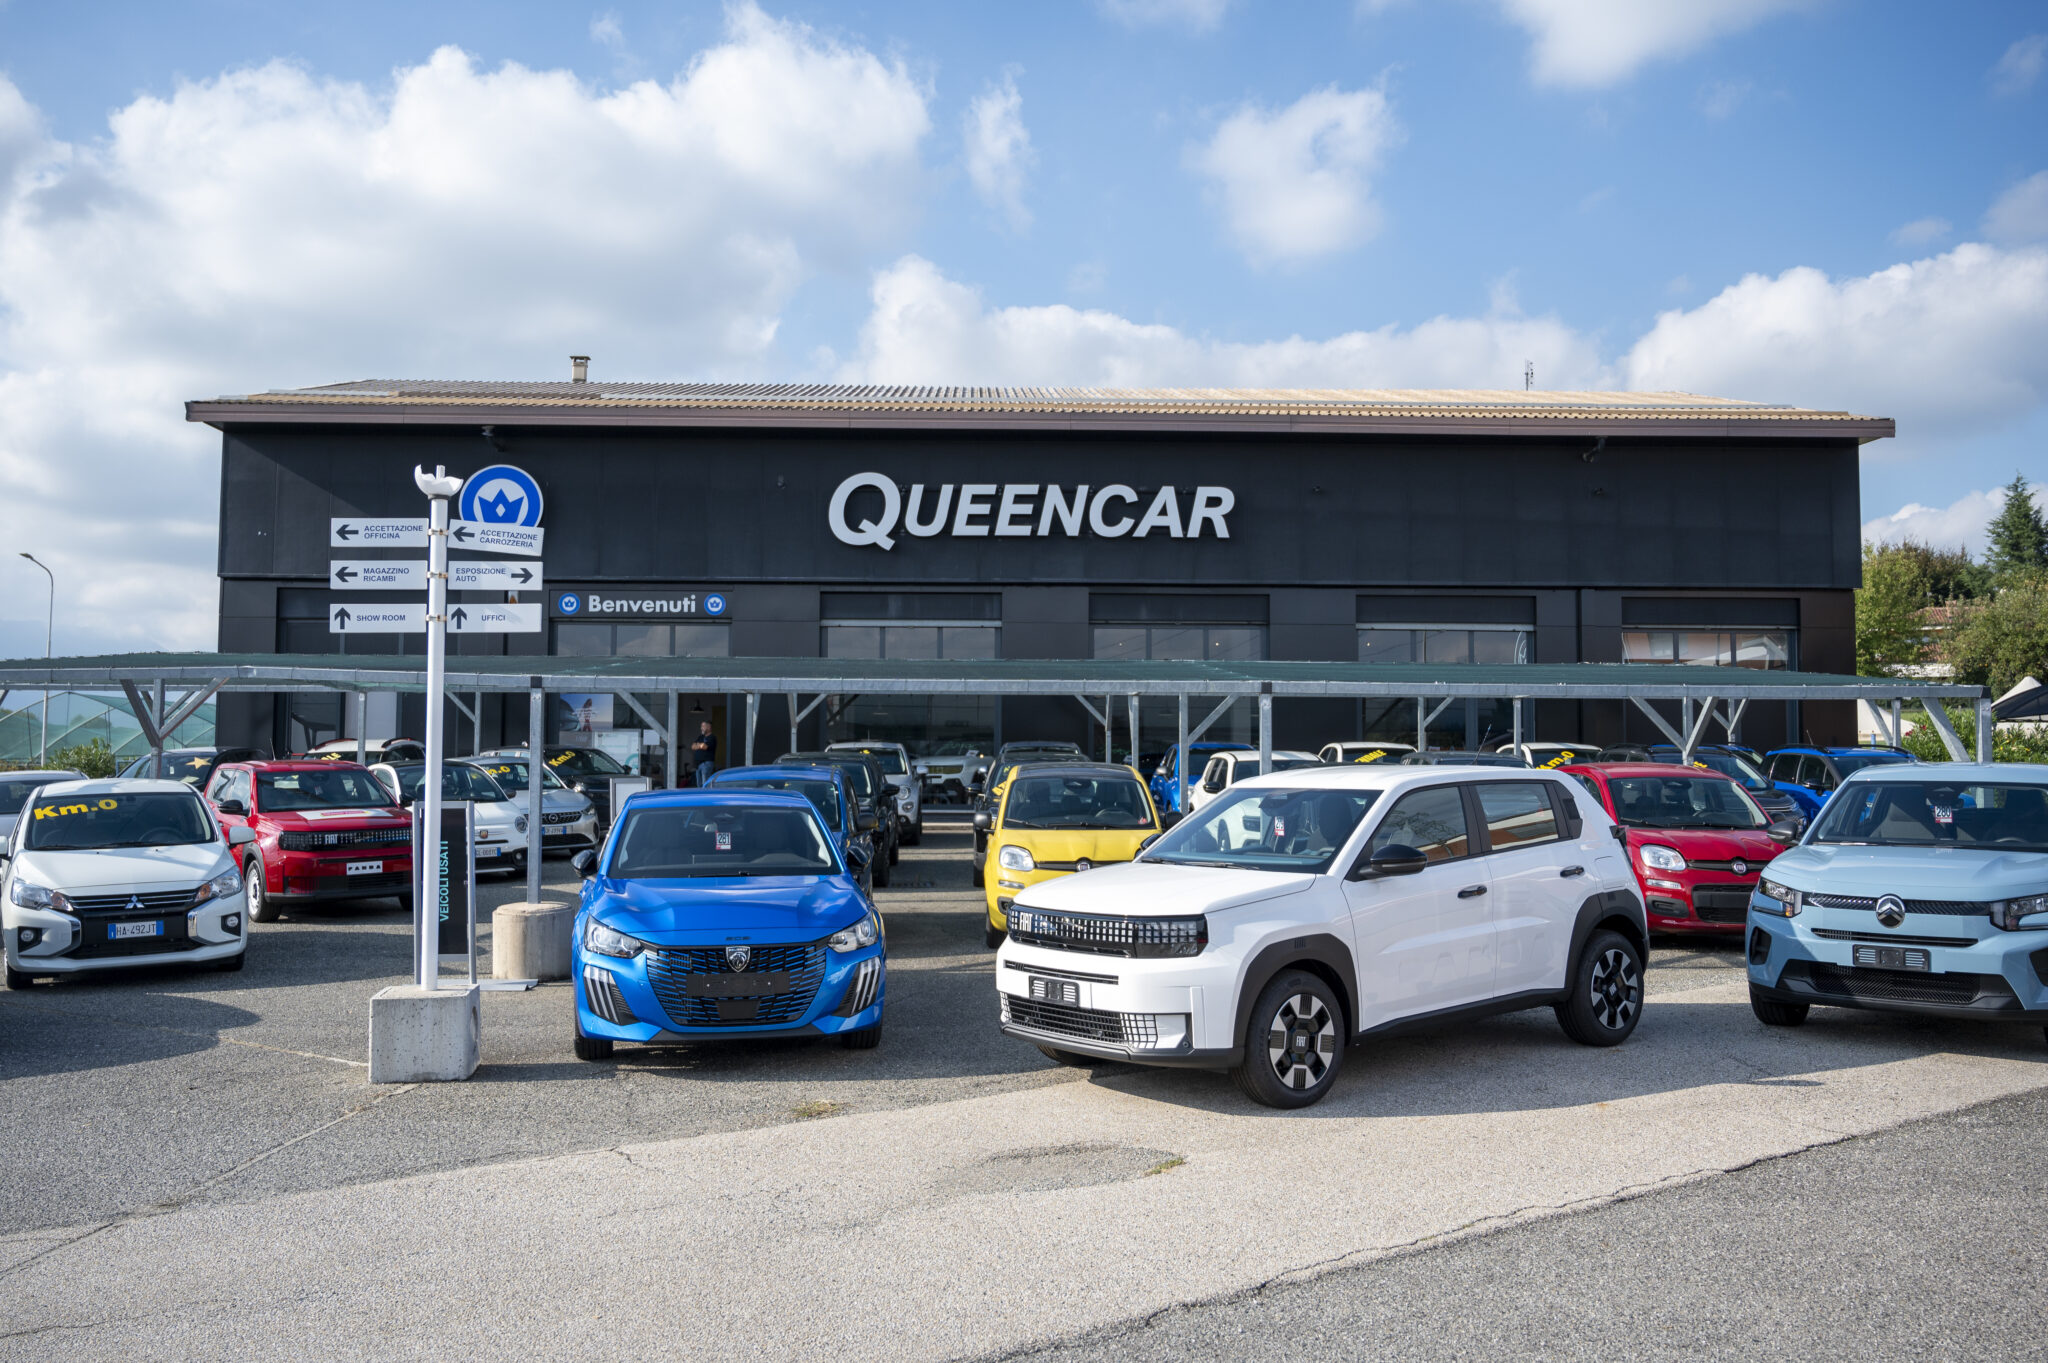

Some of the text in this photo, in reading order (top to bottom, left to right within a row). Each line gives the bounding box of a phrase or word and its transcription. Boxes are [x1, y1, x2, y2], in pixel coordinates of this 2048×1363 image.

[828, 471, 1235, 551] QUEENCAR
[479, 537, 534, 548] CARROZZERIA
[480, 529, 538, 541] ACCETTAZIONE
[588, 594, 696, 613] Benvenuti
[34, 798, 118, 821] Km.0
[1937, 807, 1951, 817] 280
[324, 833, 338, 845] FIAT
[718, 833, 730, 844] 281
[439, 840, 449, 922] VEICOLI USATI
[1019, 911, 1033, 933] FIAT
